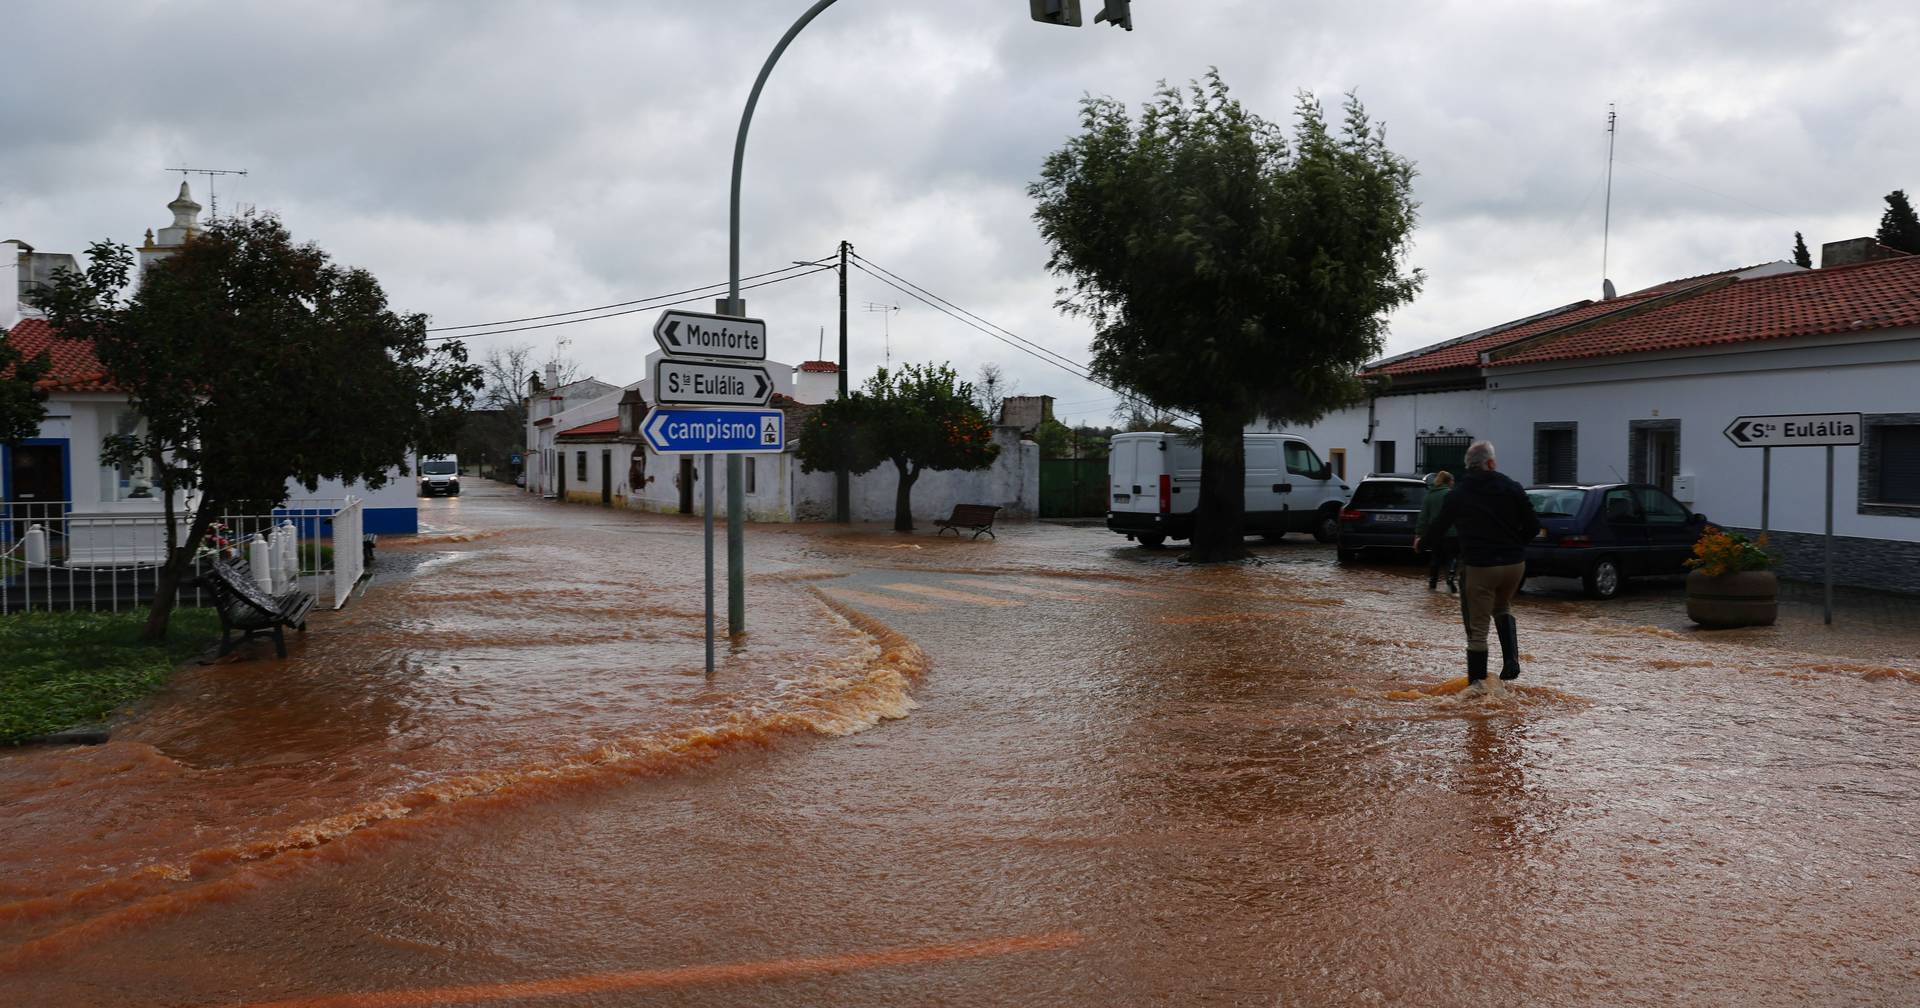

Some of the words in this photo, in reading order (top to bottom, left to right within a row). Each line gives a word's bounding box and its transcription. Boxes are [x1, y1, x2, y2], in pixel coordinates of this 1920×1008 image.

[687, 324, 759, 350] Monforte
[694, 374, 745, 396] Eulália
[668, 418, 756, 444] campismo
[1784, 421, 1855, 438] Eulália
